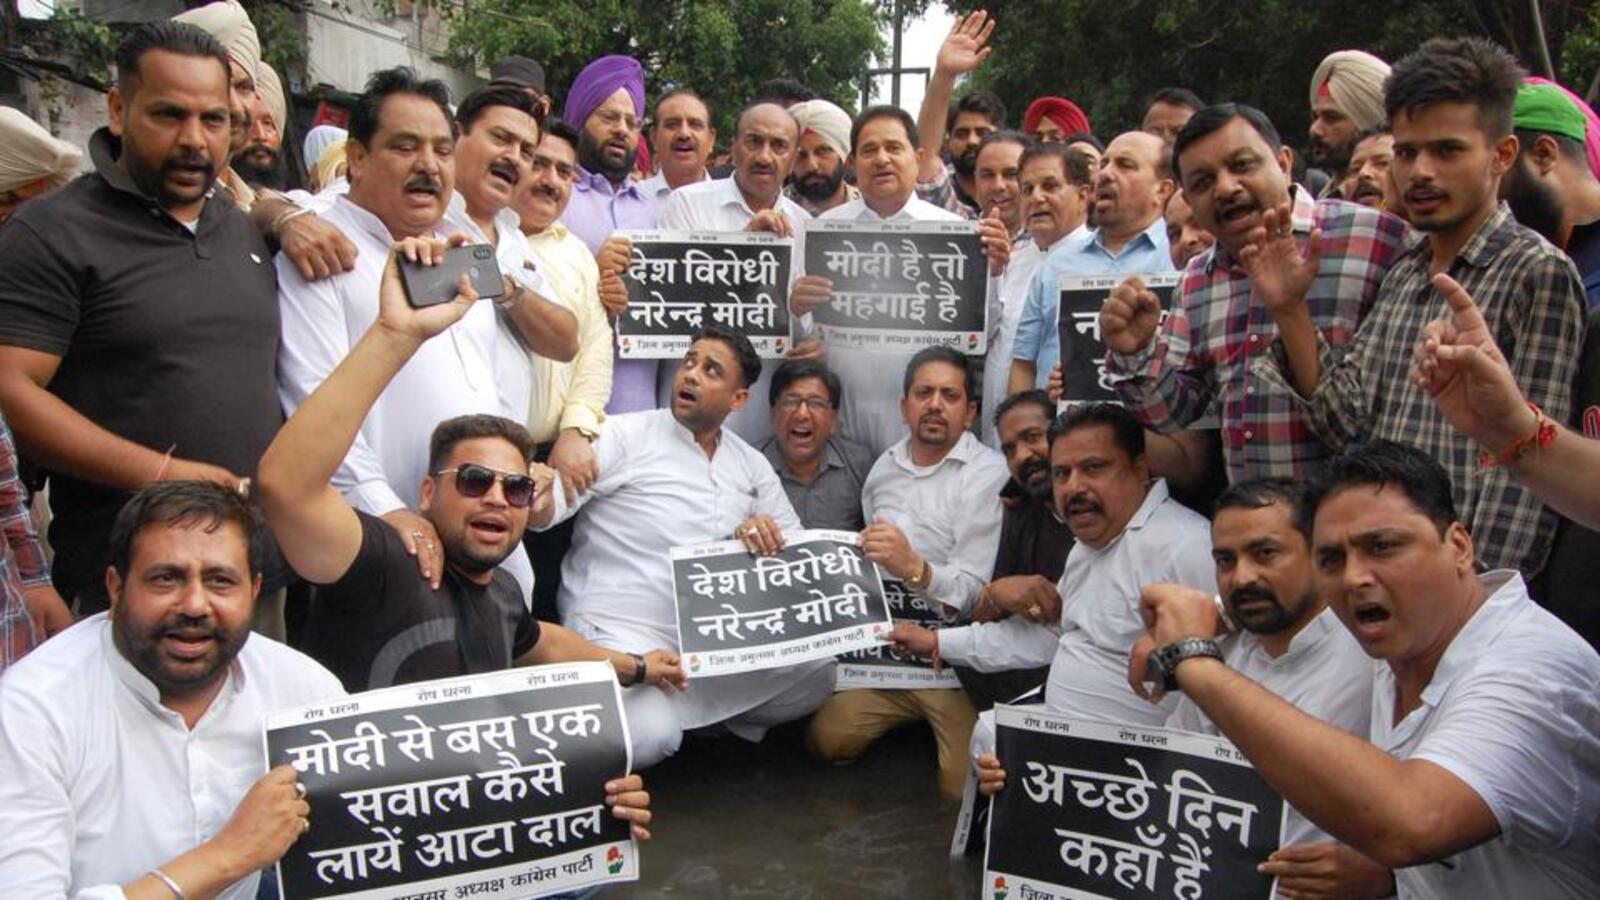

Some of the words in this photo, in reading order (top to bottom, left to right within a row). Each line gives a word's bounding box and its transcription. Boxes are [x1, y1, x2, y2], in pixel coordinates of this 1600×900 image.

[629, 248, 678, 285] देश
[682, 249, 780, 285] विरोधी
[824, 240, 895, 279] मोदी
[899, 239, 923, 281] है
[929, 242, 968, 281] तो
[628, 291, 707, 328] नरेन्द्र
[710, 292, 778, 329] मोदी
[934, 281, 961, 322] है
[687, 563, 748, 599] देश
[752, 546, 863, 592] विरोधी
[692, 604, 788, 640] नरेन्द्र
[791, 583, 869, 625] मोदी
[285, 721, 388, 775] मोदी
[390, 714, 436, 762] से
[437, 714, 517, 753] बस
[521, 704, 603, 750] एक
[340, 774, 471, 826] सवाल
[477, 748, 566, 803] कैसे
[1021, 757, 1158, 820] अच्छे
[1163, 769, 1260, 847] दिन
[309, 826, 404, 884] लायें
[415, 821, 517, 868] आटा
[521, 805, 604, 848] दाल
[1055, 825, 1167, 892] कहाँ
[1171, 832, 1212, 900] हैं
[455, 878, 505, 900] अध्यक्ष
[509, 866, 558, 887] कांग्रेस
[561, 853, 595, 875] पार्टी
